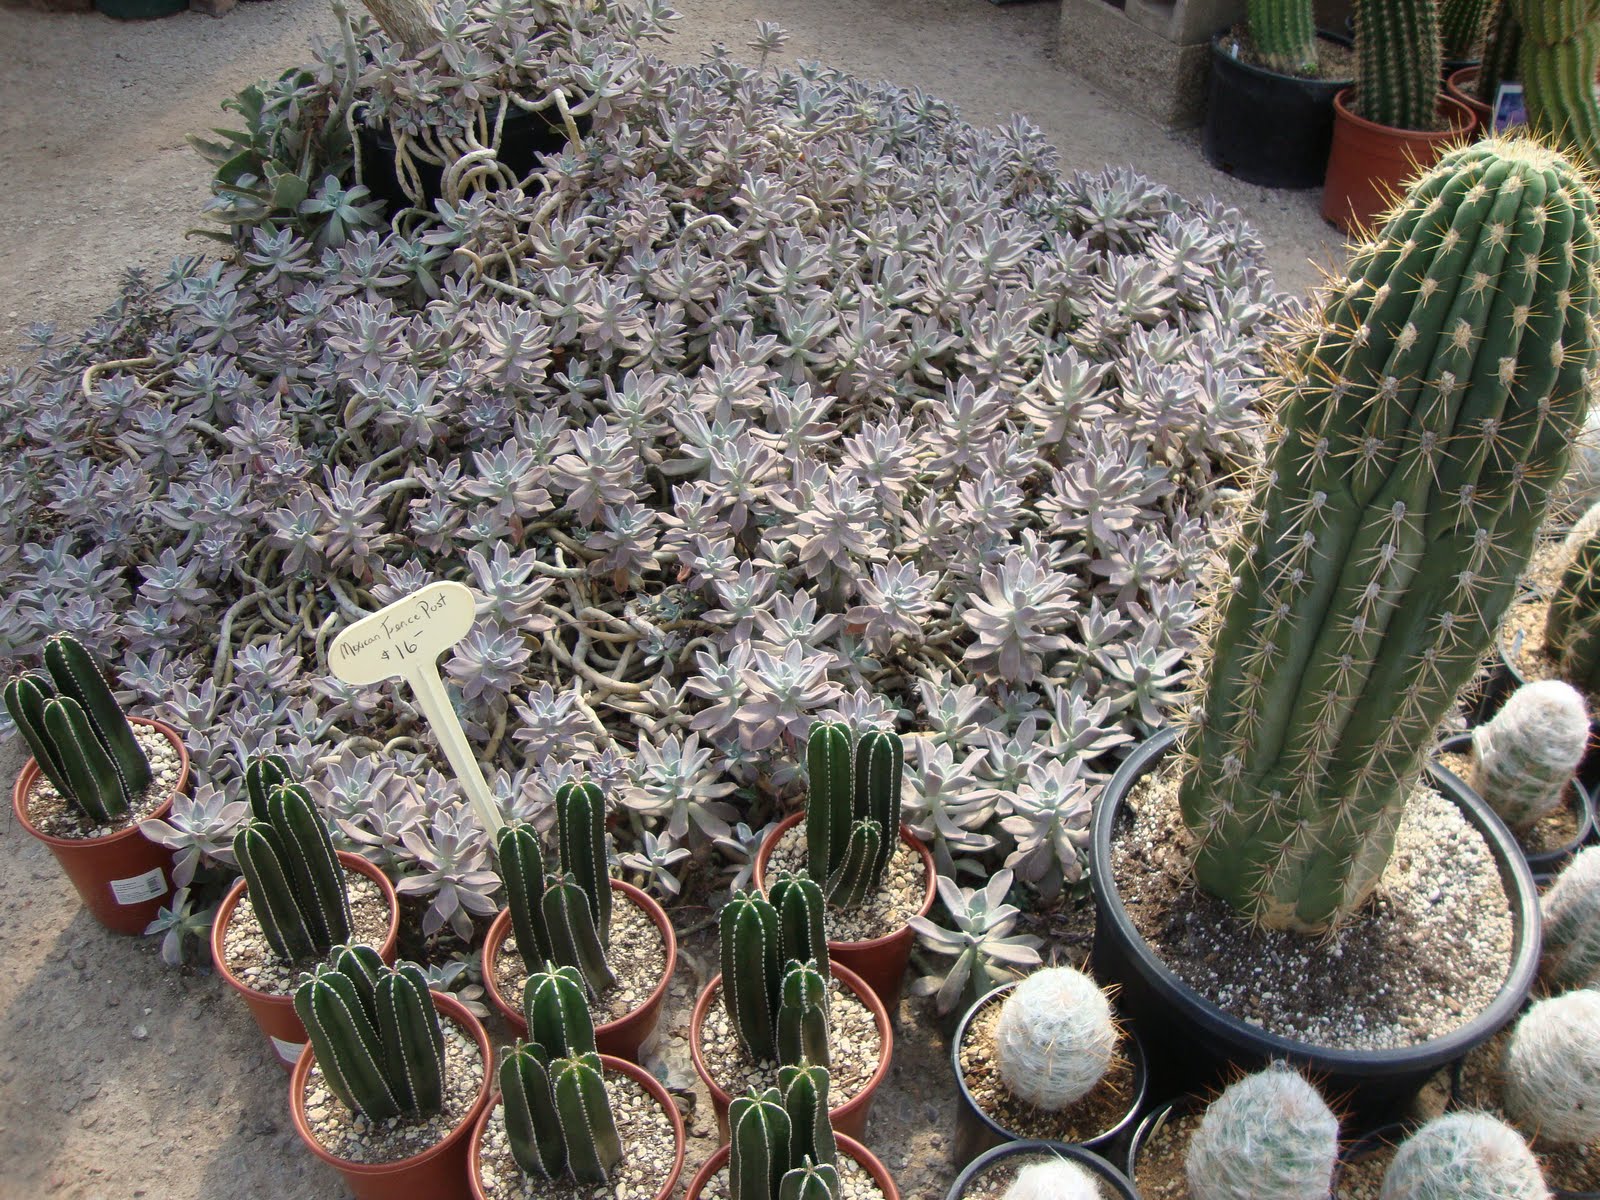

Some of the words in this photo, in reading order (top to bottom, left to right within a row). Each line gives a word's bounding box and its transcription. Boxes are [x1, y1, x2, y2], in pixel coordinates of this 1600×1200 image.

[339, 634, 382, 660] Mexican
[380, 615, 421, 640] Fence
[415, 592, 446, 619] Post
